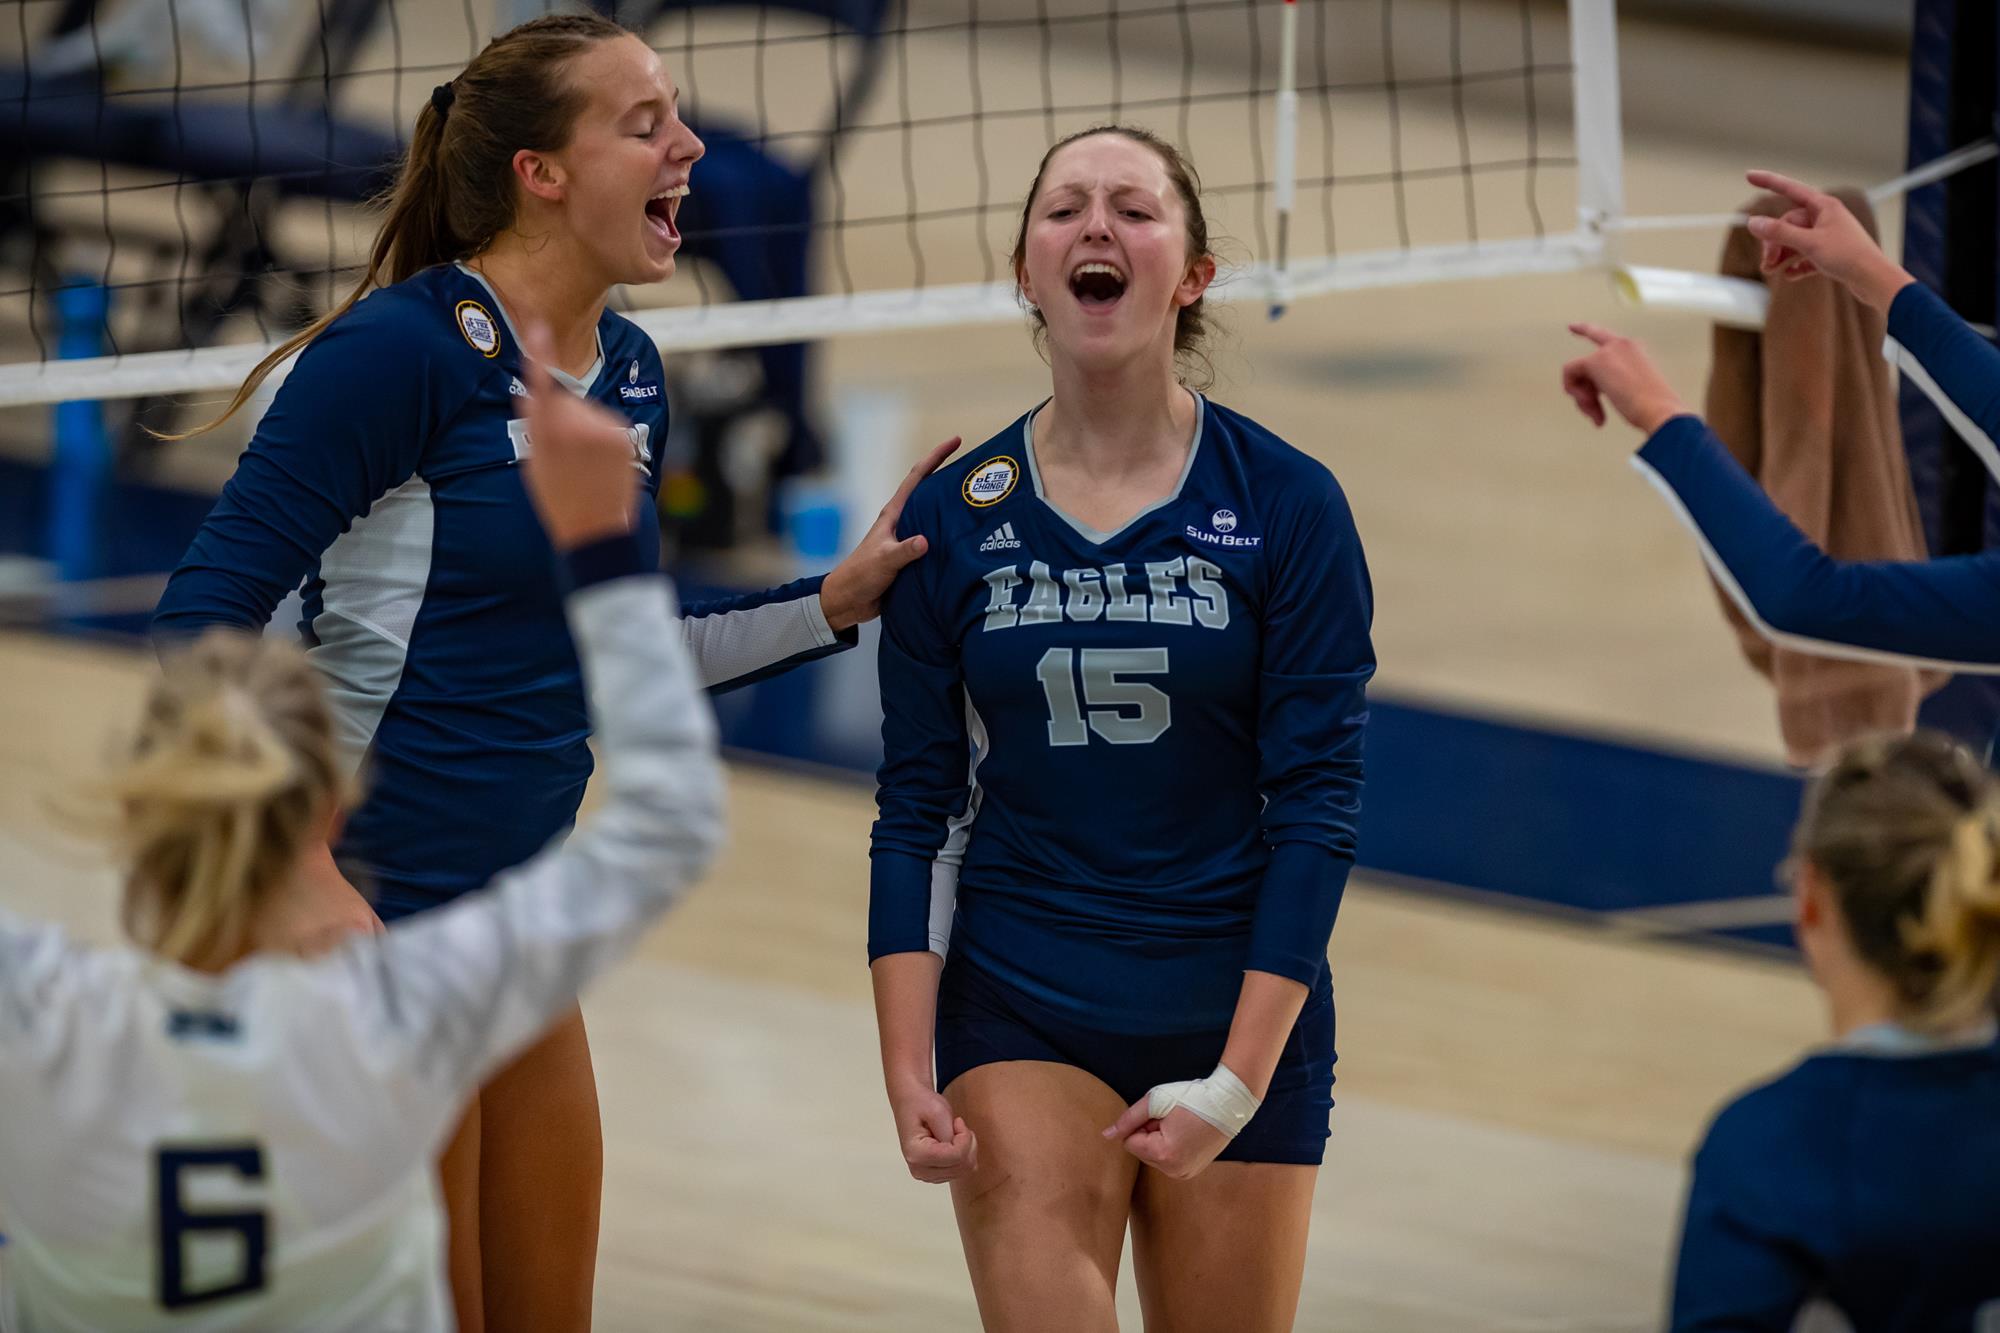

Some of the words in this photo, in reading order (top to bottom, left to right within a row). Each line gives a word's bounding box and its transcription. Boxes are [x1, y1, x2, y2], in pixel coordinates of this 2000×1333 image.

[972, 481, 1006, 491] CHANGE
[980, 538, 1021, 552] adidas
[982, 555, 1230, 632] EAGLES
[1036, 647, 1171, 746] 15
[155, 1143, 269, 1312] 6
